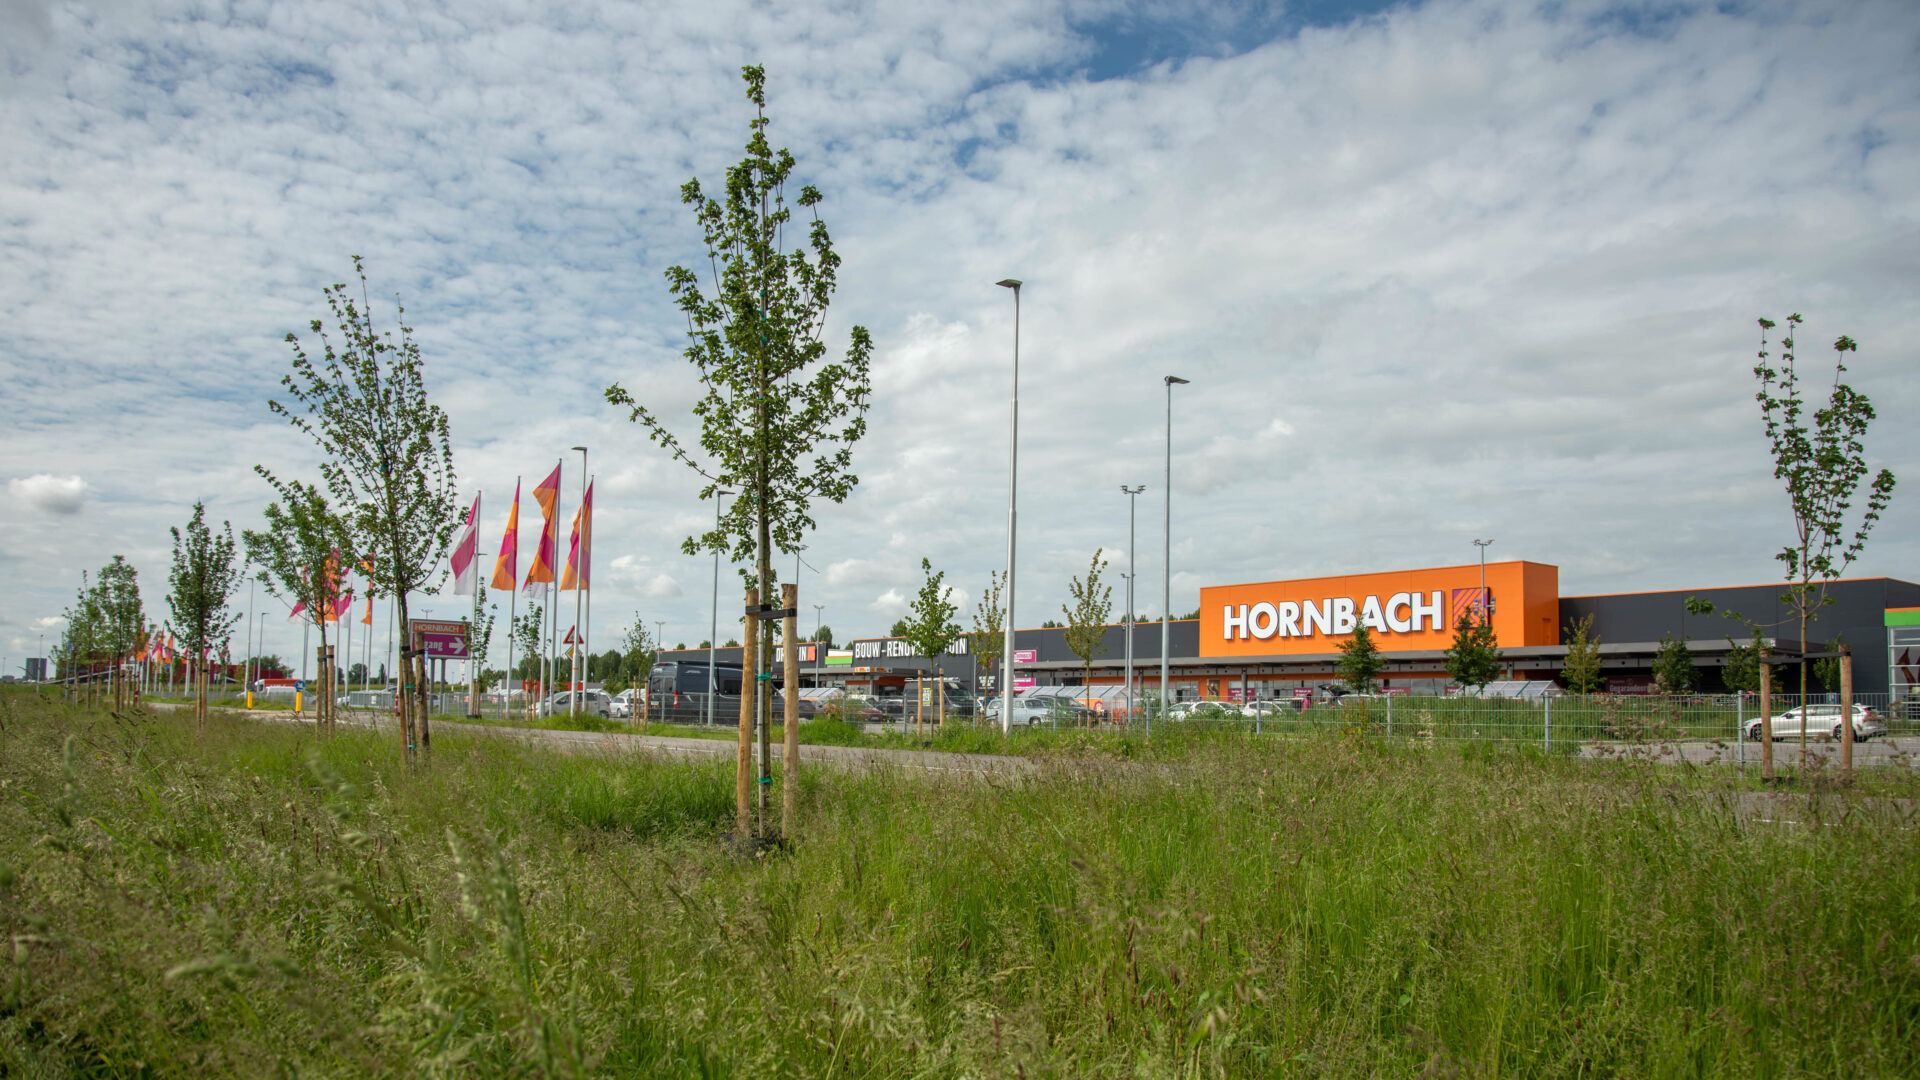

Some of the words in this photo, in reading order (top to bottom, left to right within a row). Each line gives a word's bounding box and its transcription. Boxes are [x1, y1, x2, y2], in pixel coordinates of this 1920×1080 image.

[1223, 590, 1444, 640] HORNBACH
[414, 624, 459, 633] HORNBACH
[424, 640, 443, 652] gang
